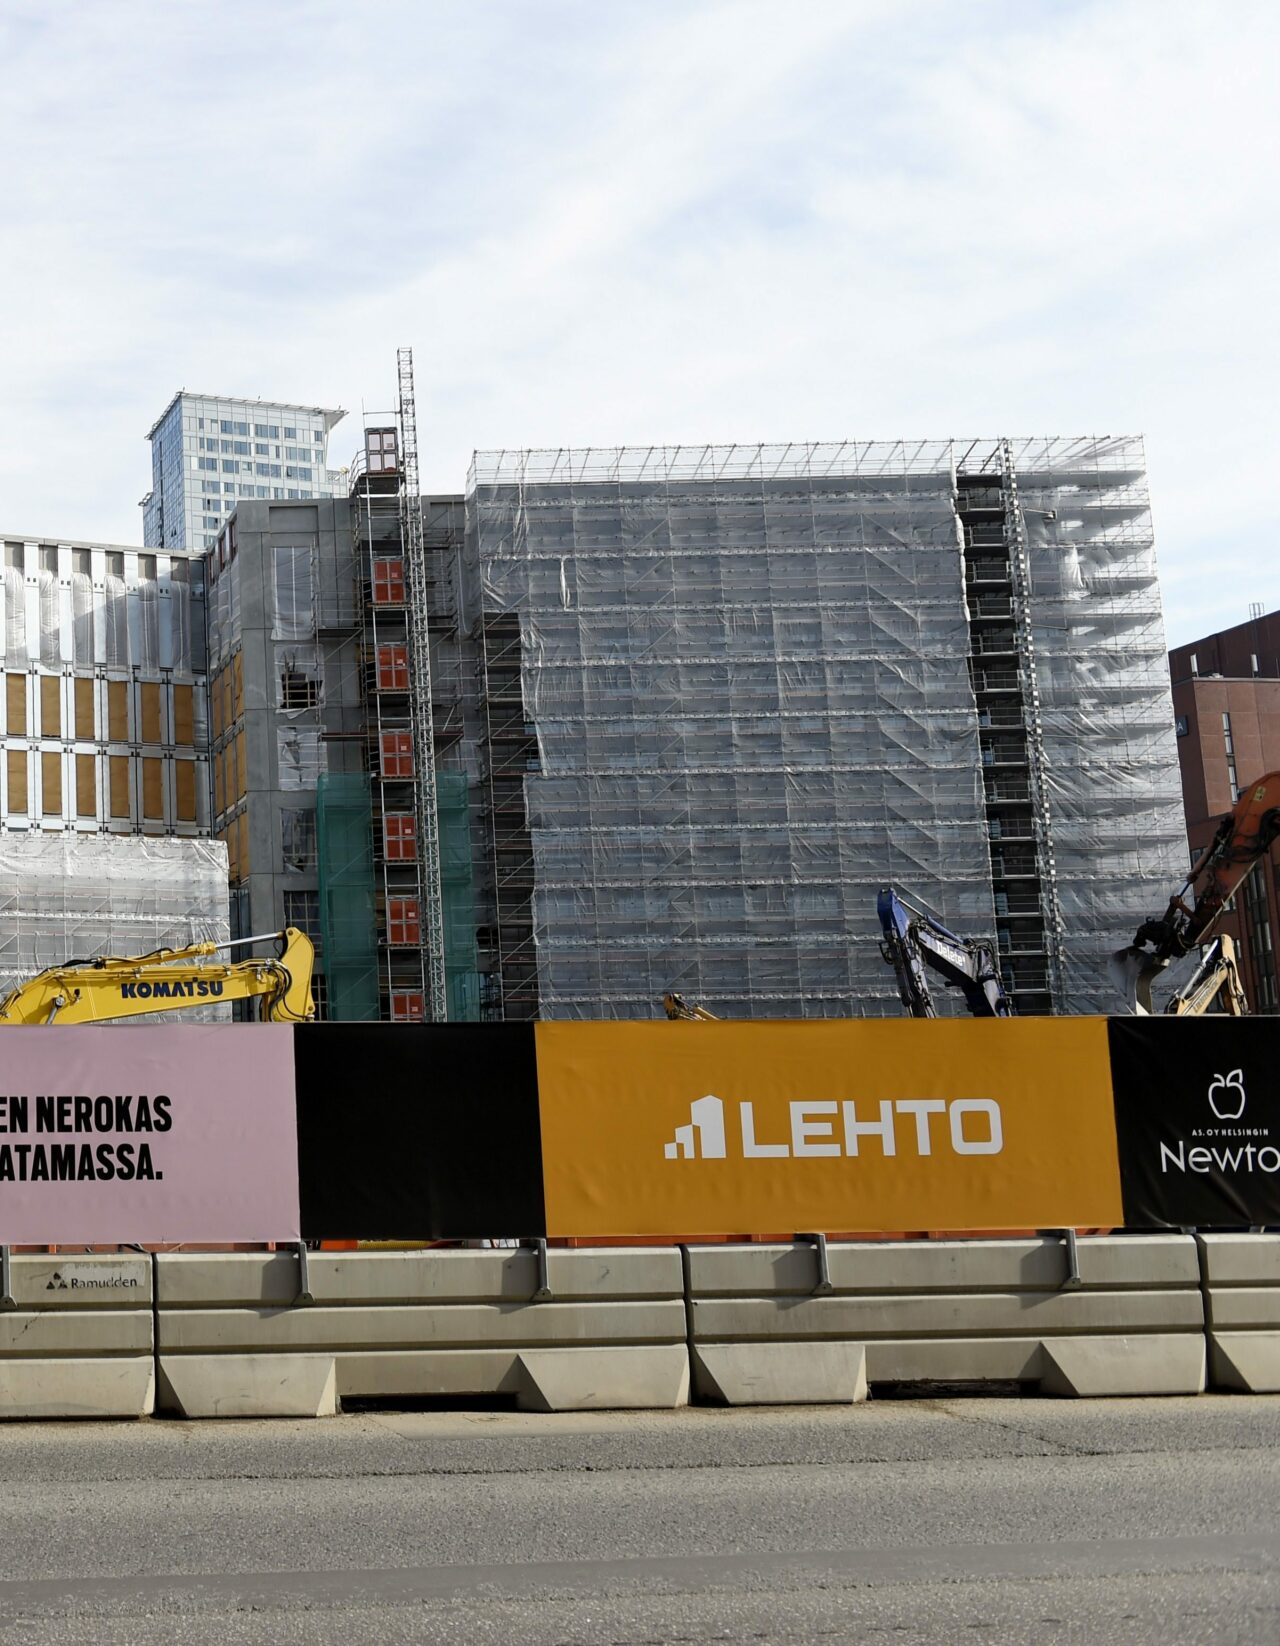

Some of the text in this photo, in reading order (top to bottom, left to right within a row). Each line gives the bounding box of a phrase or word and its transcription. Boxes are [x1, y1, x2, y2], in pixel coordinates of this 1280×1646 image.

[121, 977, 223, 999] KOMATSU
[36, 1095, 173, 1133] NEROKAS
[740, 1099, 1003, 1158] LEHTO
[1192, 1128, 1269, 1137] AS. OY HELSINGIN
[71, 1275, 138, 1289] Ramudden
